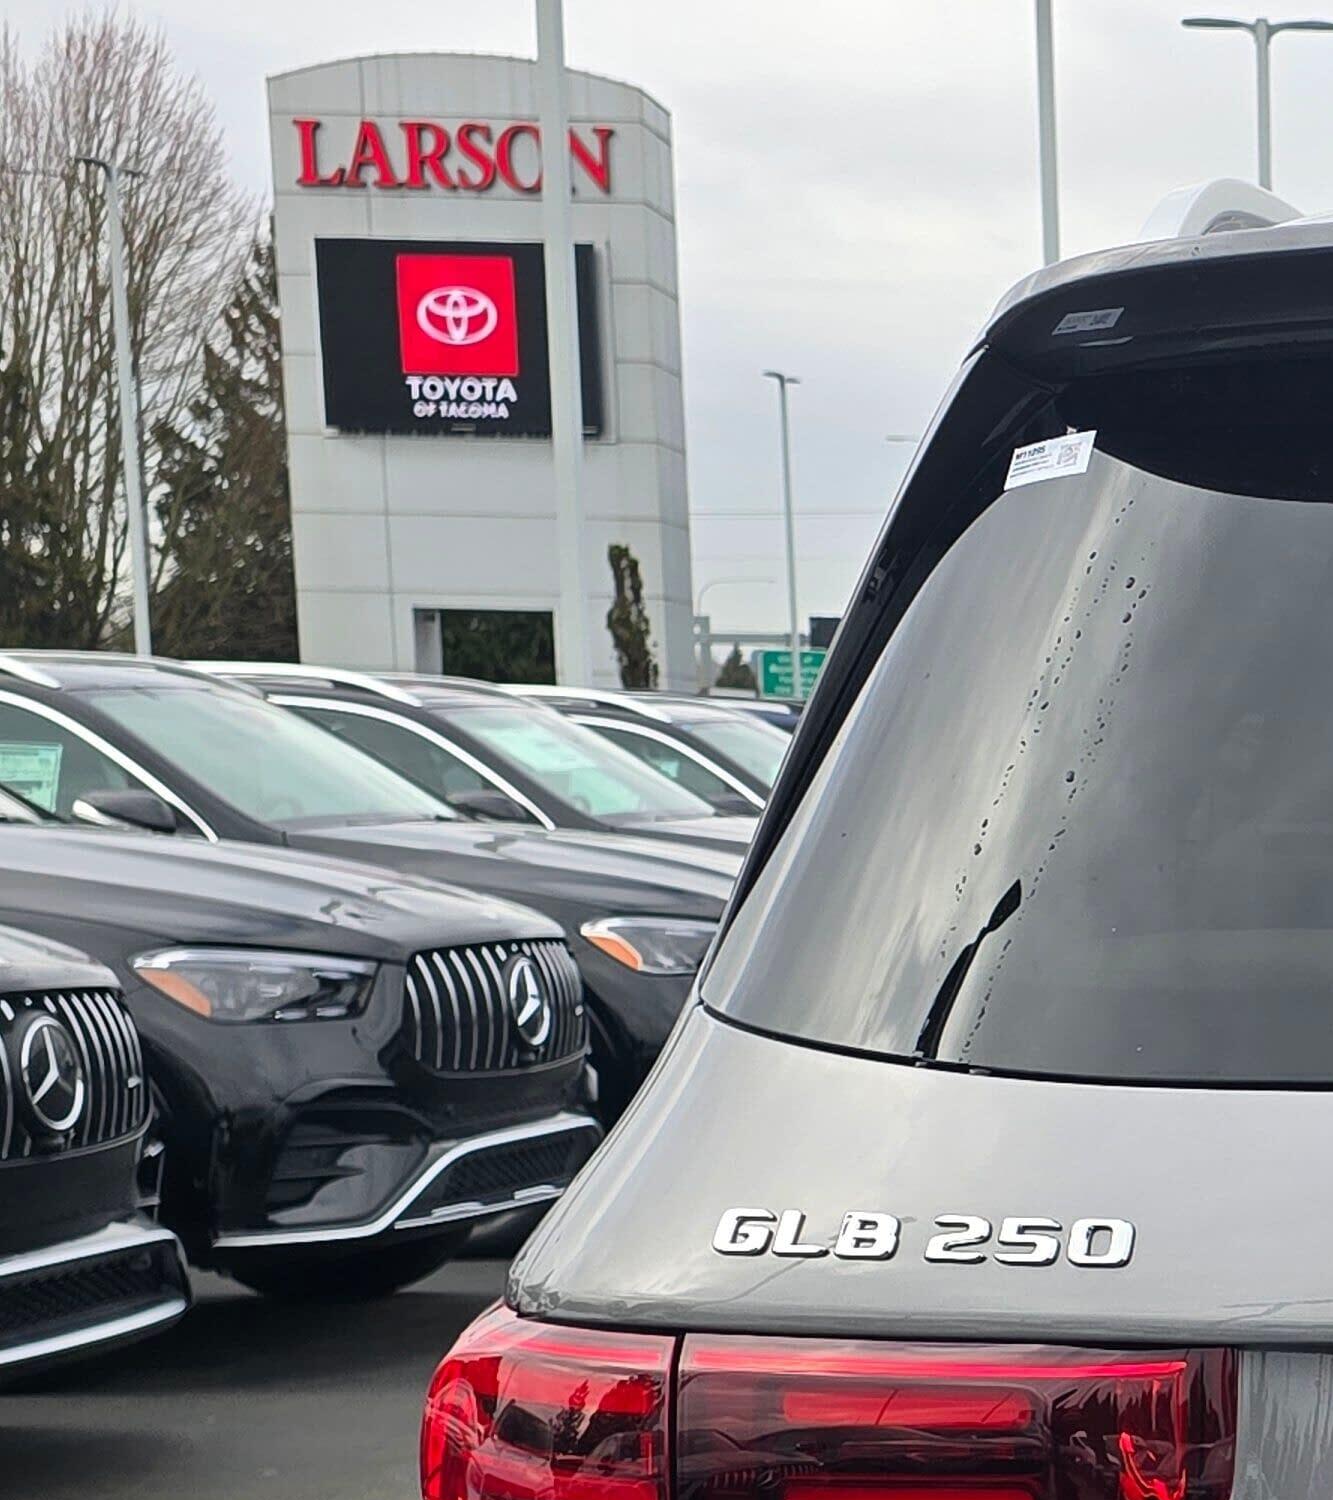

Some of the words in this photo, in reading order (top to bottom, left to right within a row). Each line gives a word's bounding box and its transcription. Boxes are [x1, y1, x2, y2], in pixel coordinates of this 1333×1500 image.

[294, 118, 616, 195] LARSON
[405, 376, 518, 402] TOYOTA
[413, 401, 437, 418] OF
[439, 401, 509, 419] TACOMA
[711, 1208, 900, 1260] GLB
[923, 1214, 1137, 1267] 250
